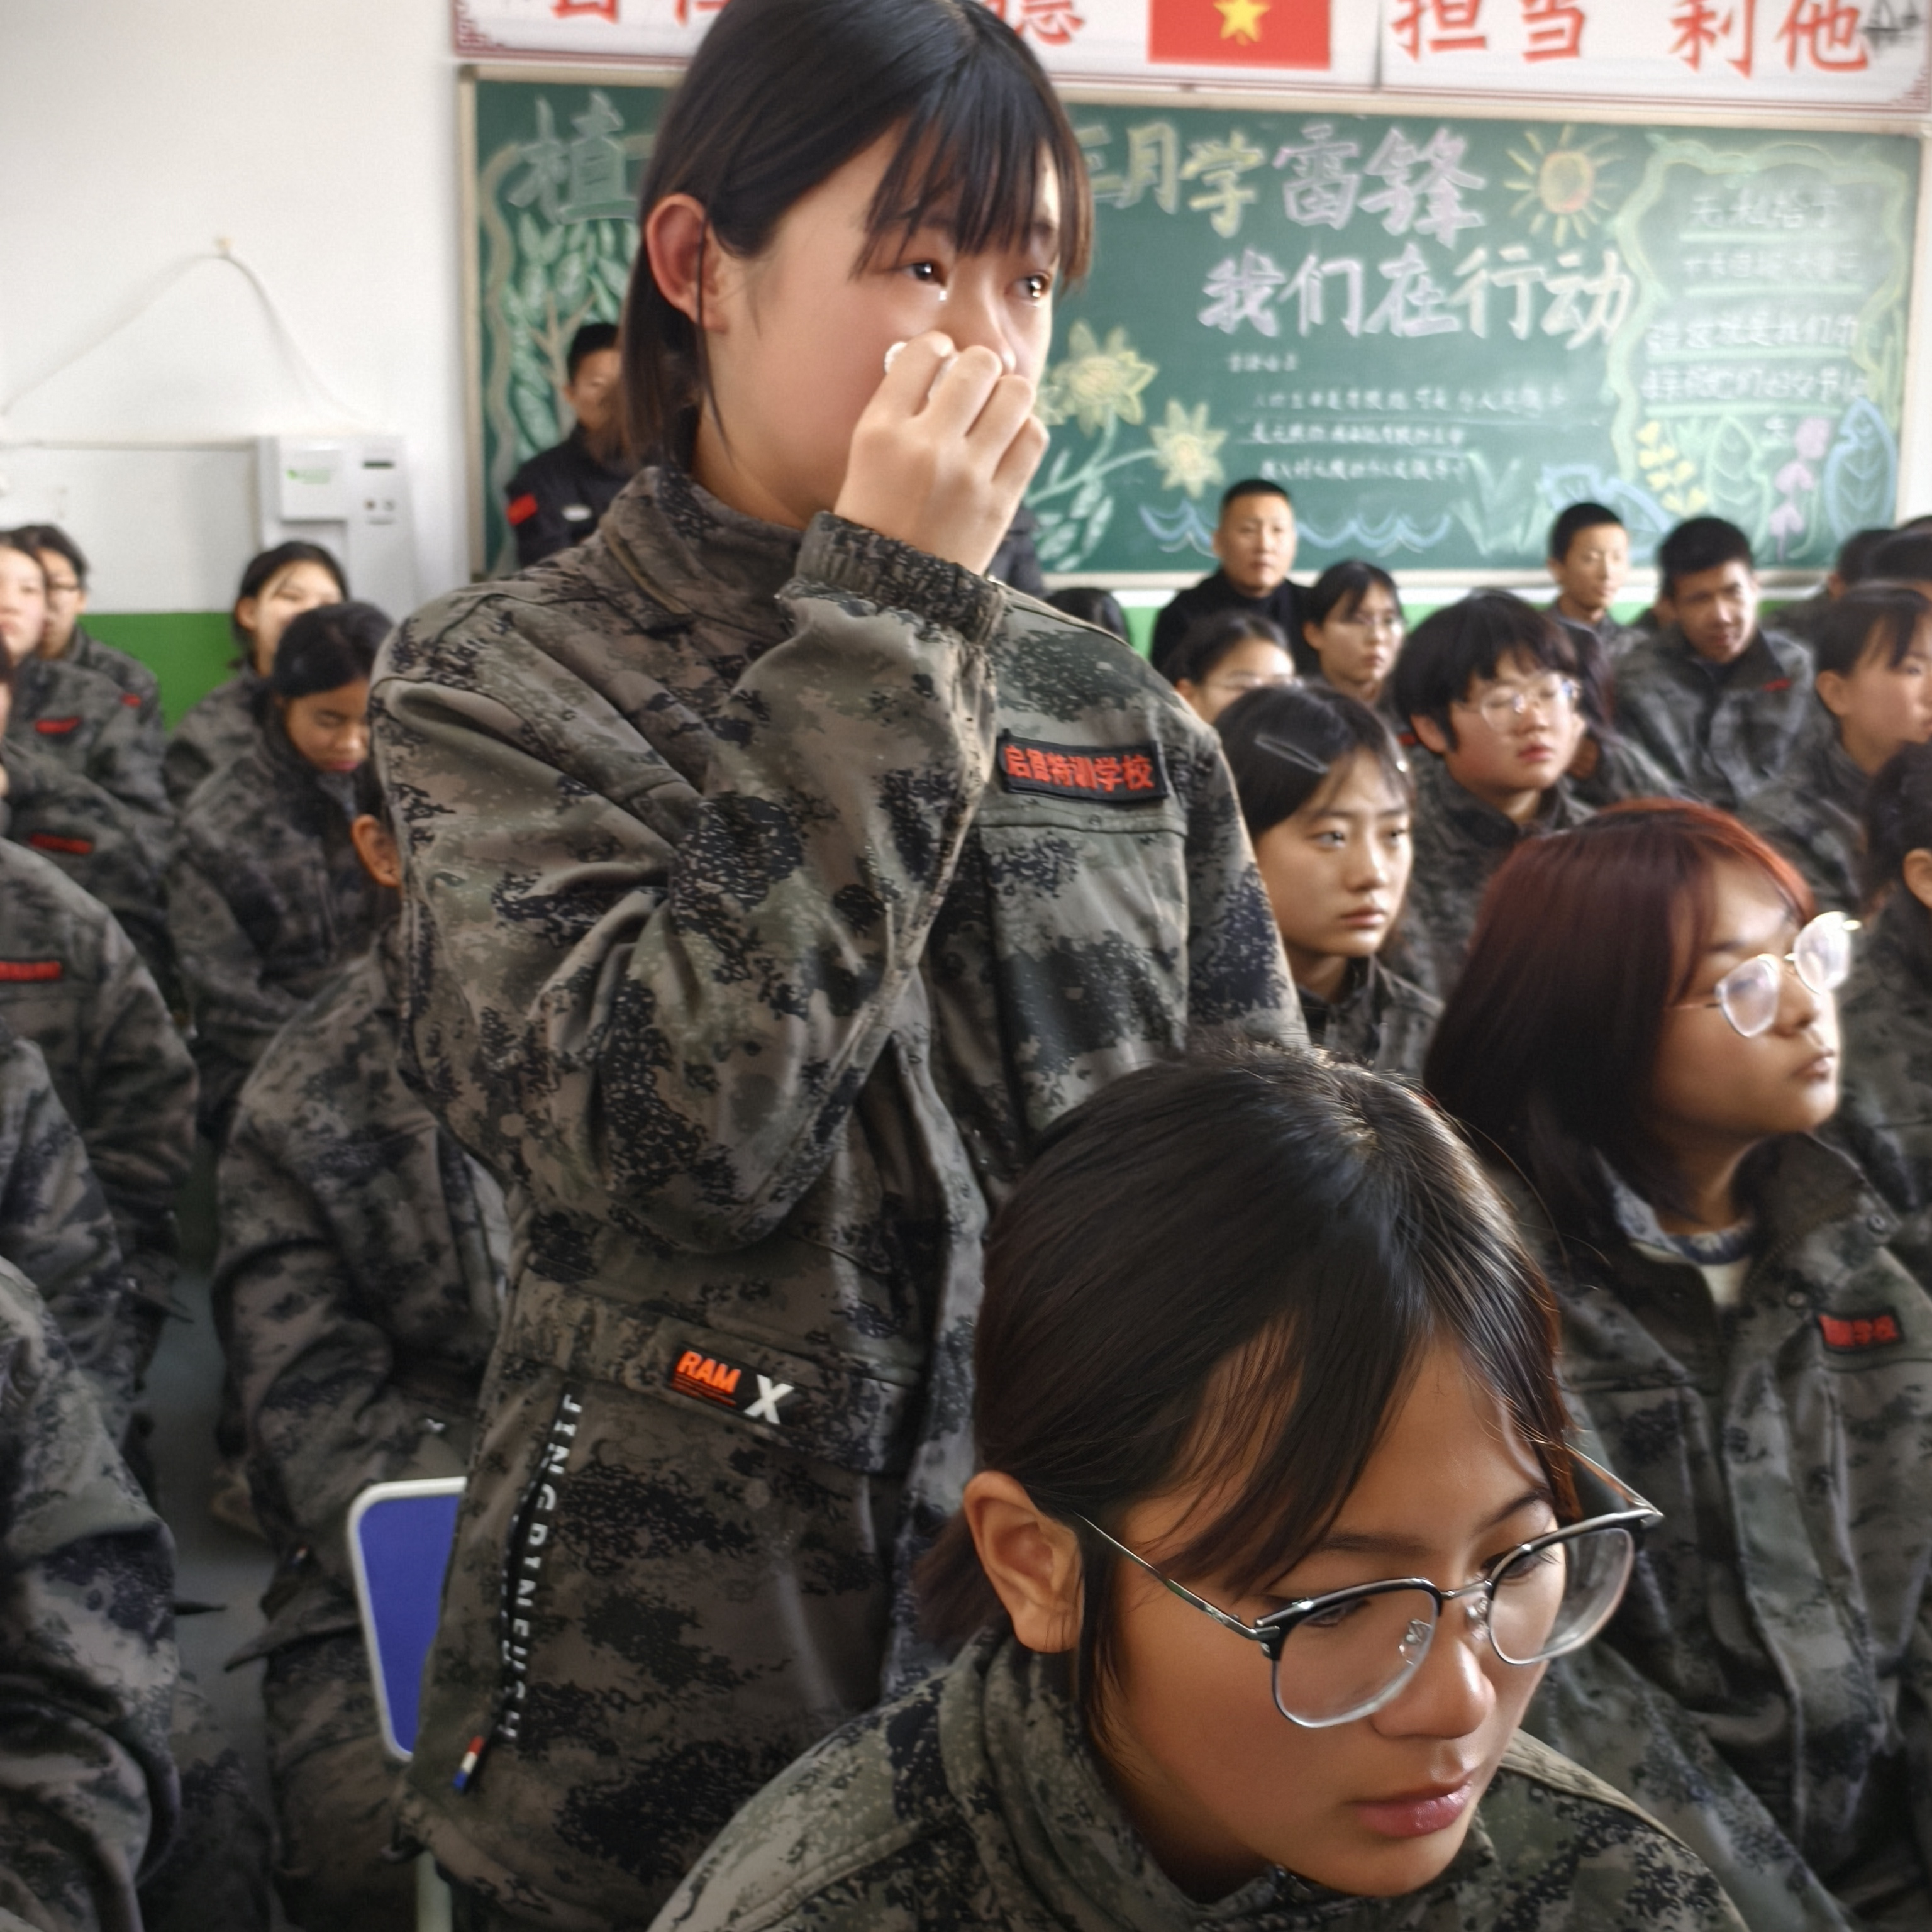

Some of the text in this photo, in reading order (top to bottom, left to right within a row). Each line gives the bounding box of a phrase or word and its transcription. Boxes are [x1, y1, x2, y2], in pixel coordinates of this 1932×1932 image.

[1391, 0, 1869, 79] 担当 利他
[1198, 242, 1634, 349] 我们在行动
[675, 1350, 795, 1424] RAM X
